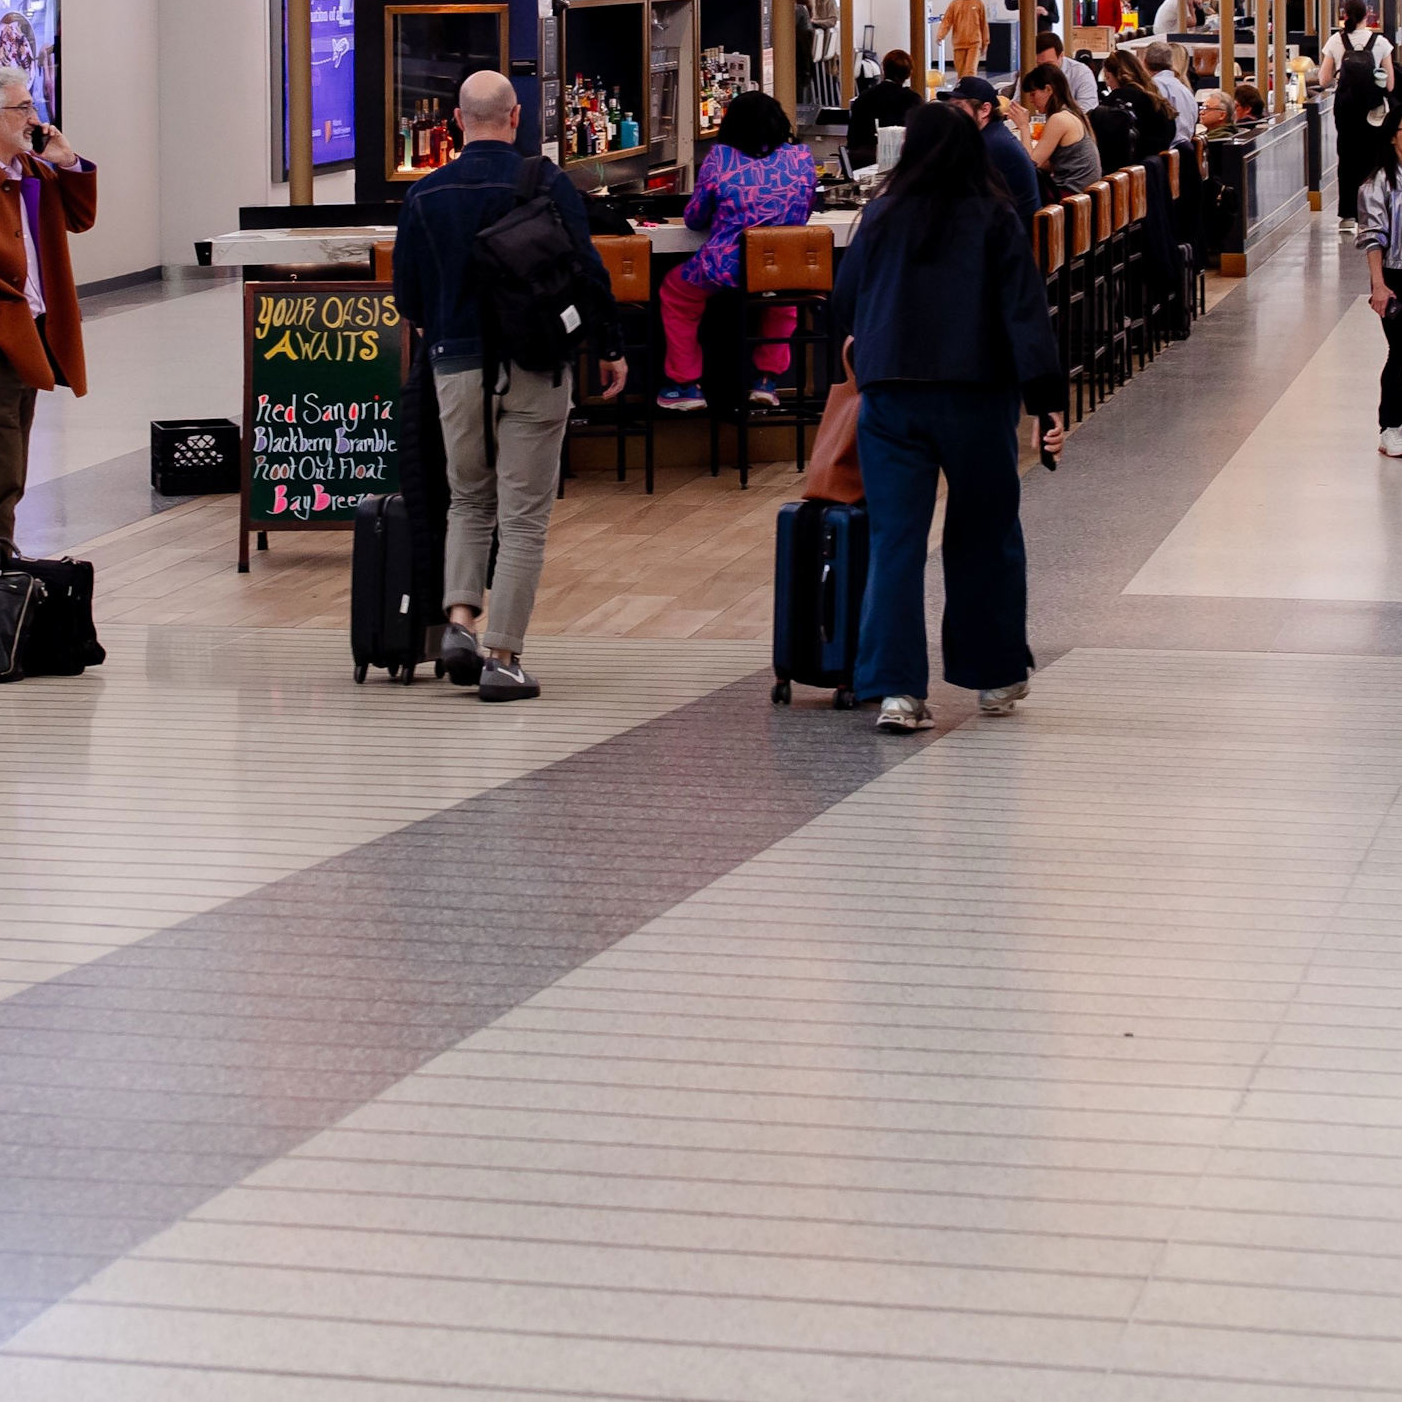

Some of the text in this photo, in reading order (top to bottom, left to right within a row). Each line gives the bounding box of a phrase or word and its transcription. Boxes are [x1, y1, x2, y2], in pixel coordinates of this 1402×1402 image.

[255, 295, 400, 339] YOUR OASIS
[264, 330, 379, 362] AWAITS
[256, 393, 393, 432] Red Sangria
[253, 426, 397, 466] Blackberry Bramble
[253, 455, 387, 480] Root Out Float
[266, 484, 311, 520] Bay
